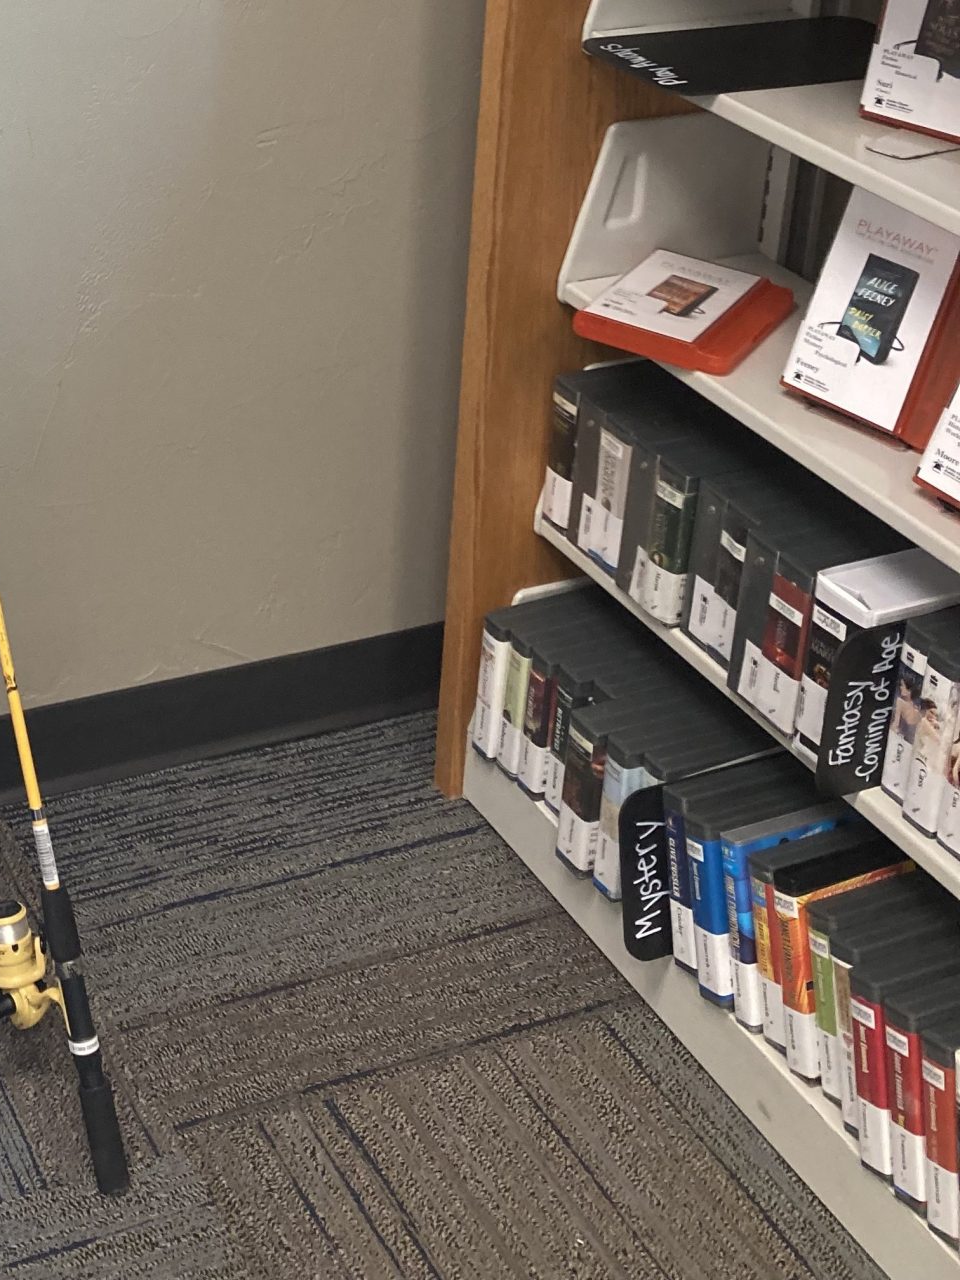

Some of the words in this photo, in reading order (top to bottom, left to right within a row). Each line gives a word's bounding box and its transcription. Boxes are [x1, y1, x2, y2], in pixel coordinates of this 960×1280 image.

[857, 287, 895, 307] FEENEY
[866, 276, 898, 295] ALICE
[872, 633, 902, 674] Age
[870, 677, 890, 701] of
[553, 707, 563, 751] BETRAYED
[829, 681, 873, 766] Fantasy
[918, 767, 928, 788] Cass
[668, 837, 677, 860] CLIVE
[633, 821, 671, 939] Mystery
[670, 861, 681, 898] CUSSLER
